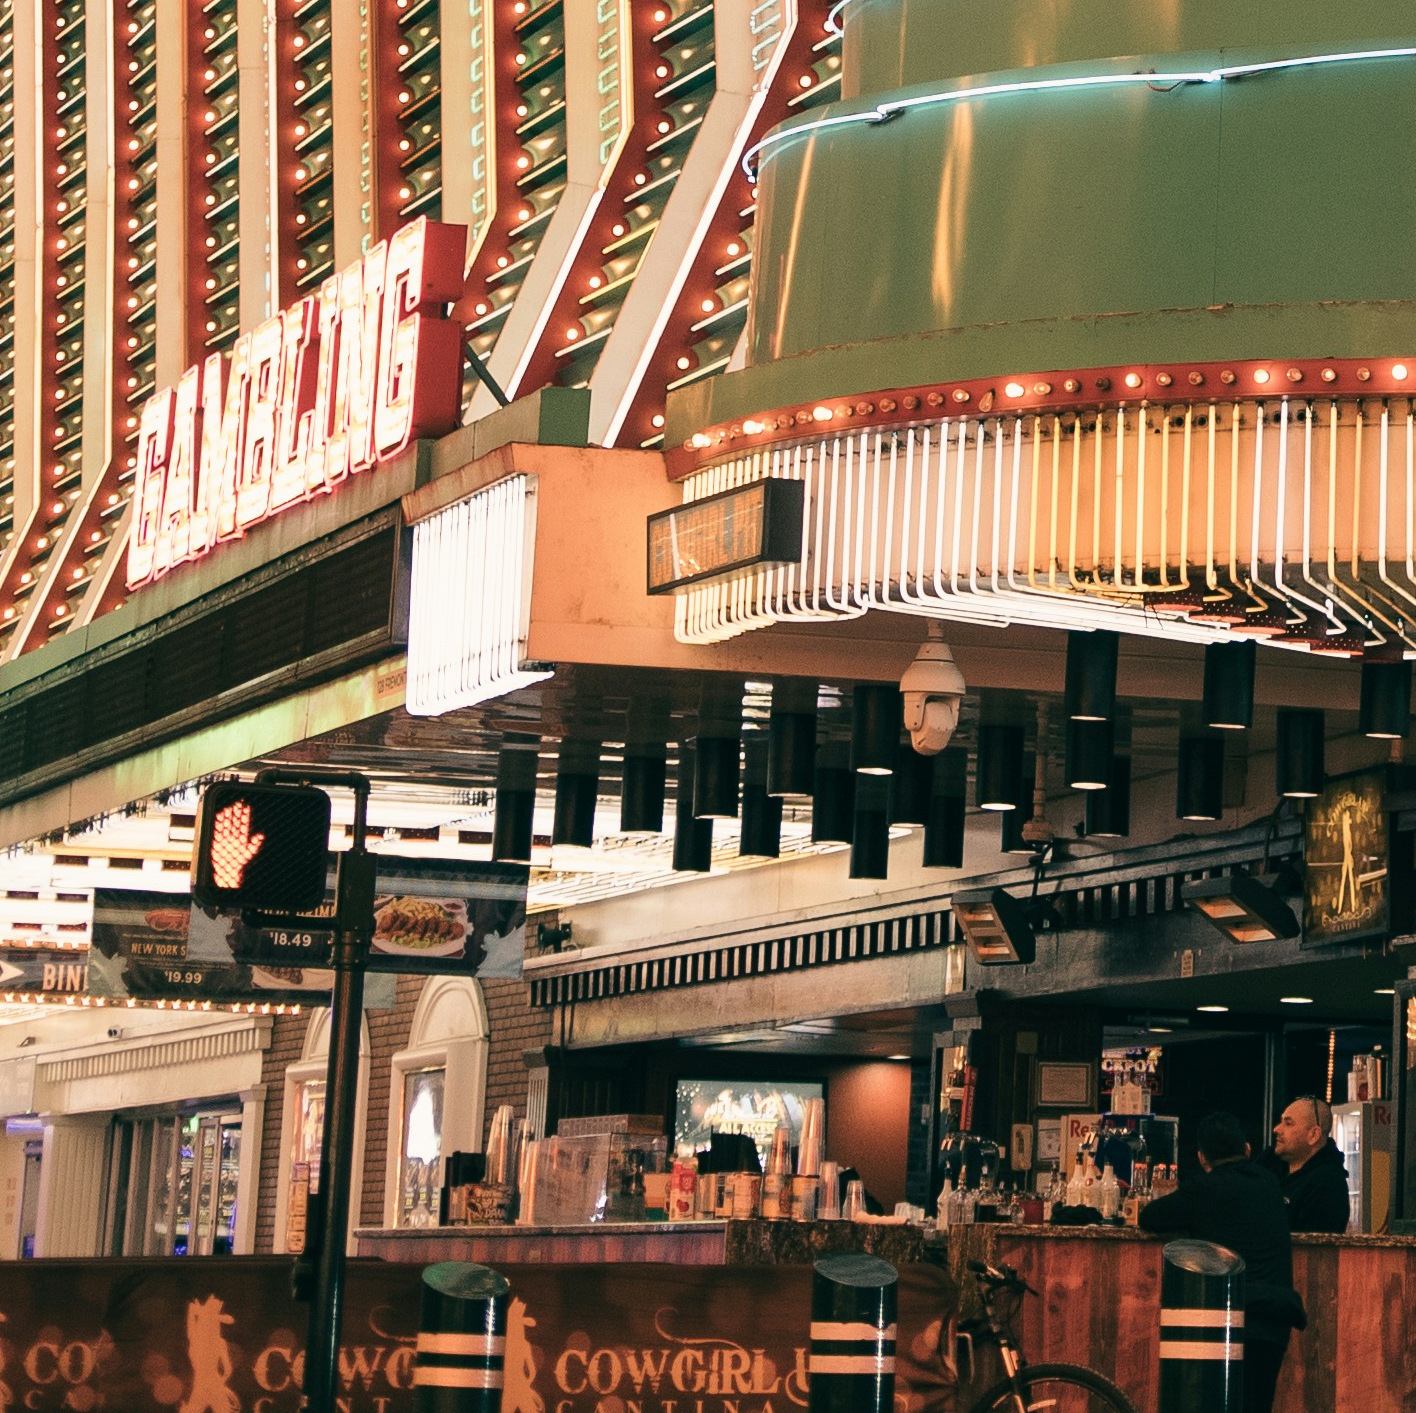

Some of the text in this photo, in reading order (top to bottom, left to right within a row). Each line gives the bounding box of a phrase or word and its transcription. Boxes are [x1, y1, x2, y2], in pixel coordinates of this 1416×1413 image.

[126, 215, 428, 591] GAMBLING
[269, 931, 312, 947] $18.49
[131, 943, 154, 955] NEW
[155, 944, 178, 956] YORK
[164, 970, 202, 985] $19.99
[1374, 1104, 1391, 1126] R
[553, 1348, 783, 1396] COWGIRL
